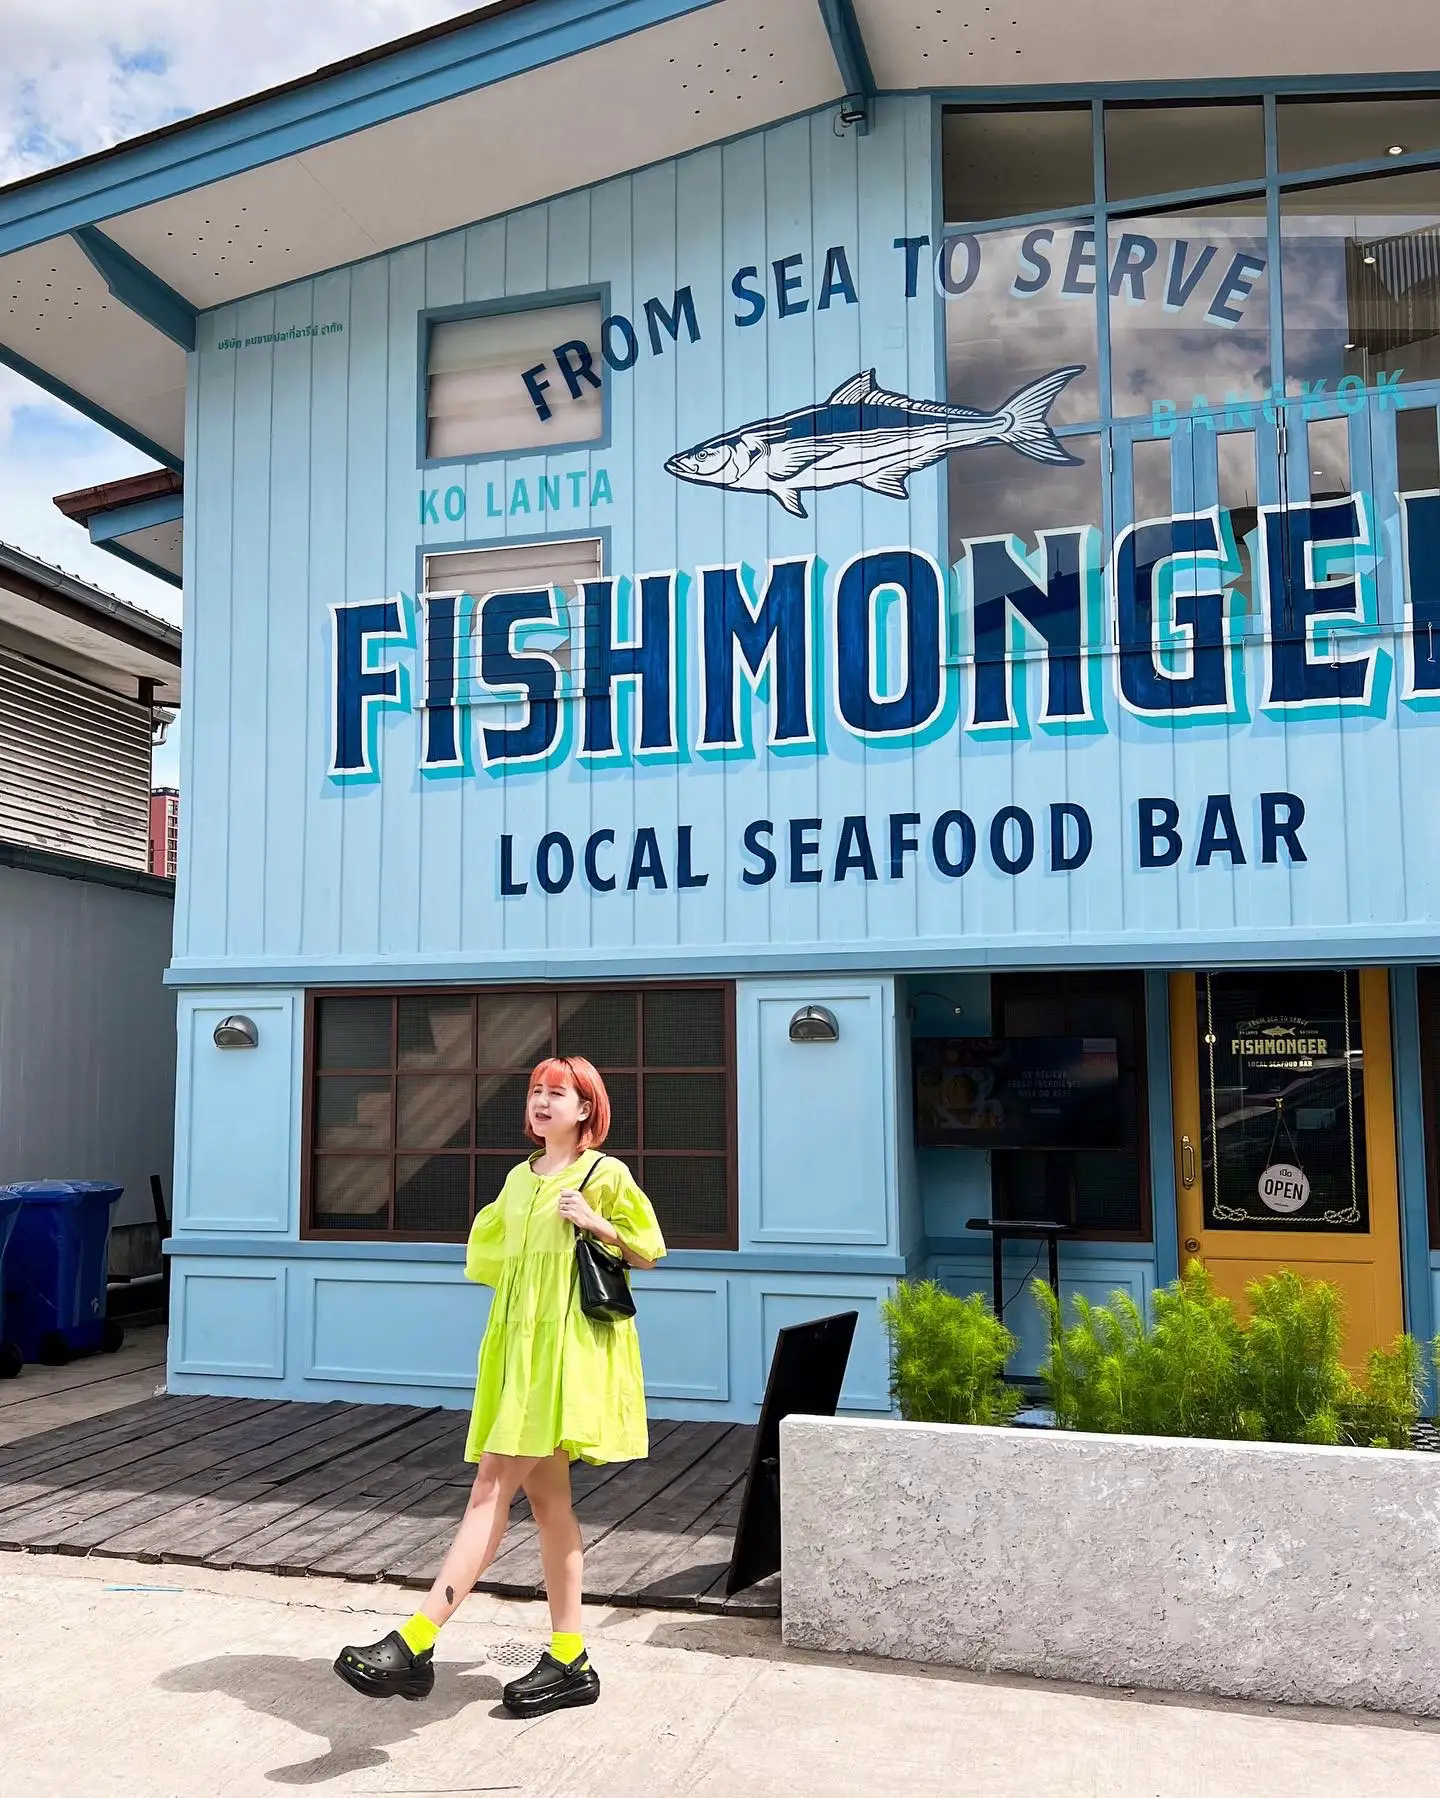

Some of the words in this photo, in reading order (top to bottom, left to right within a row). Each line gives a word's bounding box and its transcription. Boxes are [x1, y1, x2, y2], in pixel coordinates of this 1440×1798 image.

[218, 337, 242, 350] บริษัท
[520, 285, 701, 422] FROM
[731, 245, 859, 327] SEA
[893, 234, 982, 298] TO
[1010, 228, 1267, 328] SERVE
[1152, 368, 1407, 437] BANGKOK
[418, 488, 467, 525] KO
[486, 468, 614, 518] LANTA
[500, 824, 709, 896] LOCAL
[742, 803, 1093, 885] SEAFOOD
[1138, 792, 1309, 868] BAR
[1231, 1038, 1328, 1055] FISHMONGER
[1247, 1060, 1268, 1068] LOCAL
[1269, 1060, 1298, 1068] SEAFOOD
[1299, 1060, 1313, 1068] BAR
[1264, 1179, 1304, 1200] OPEN
